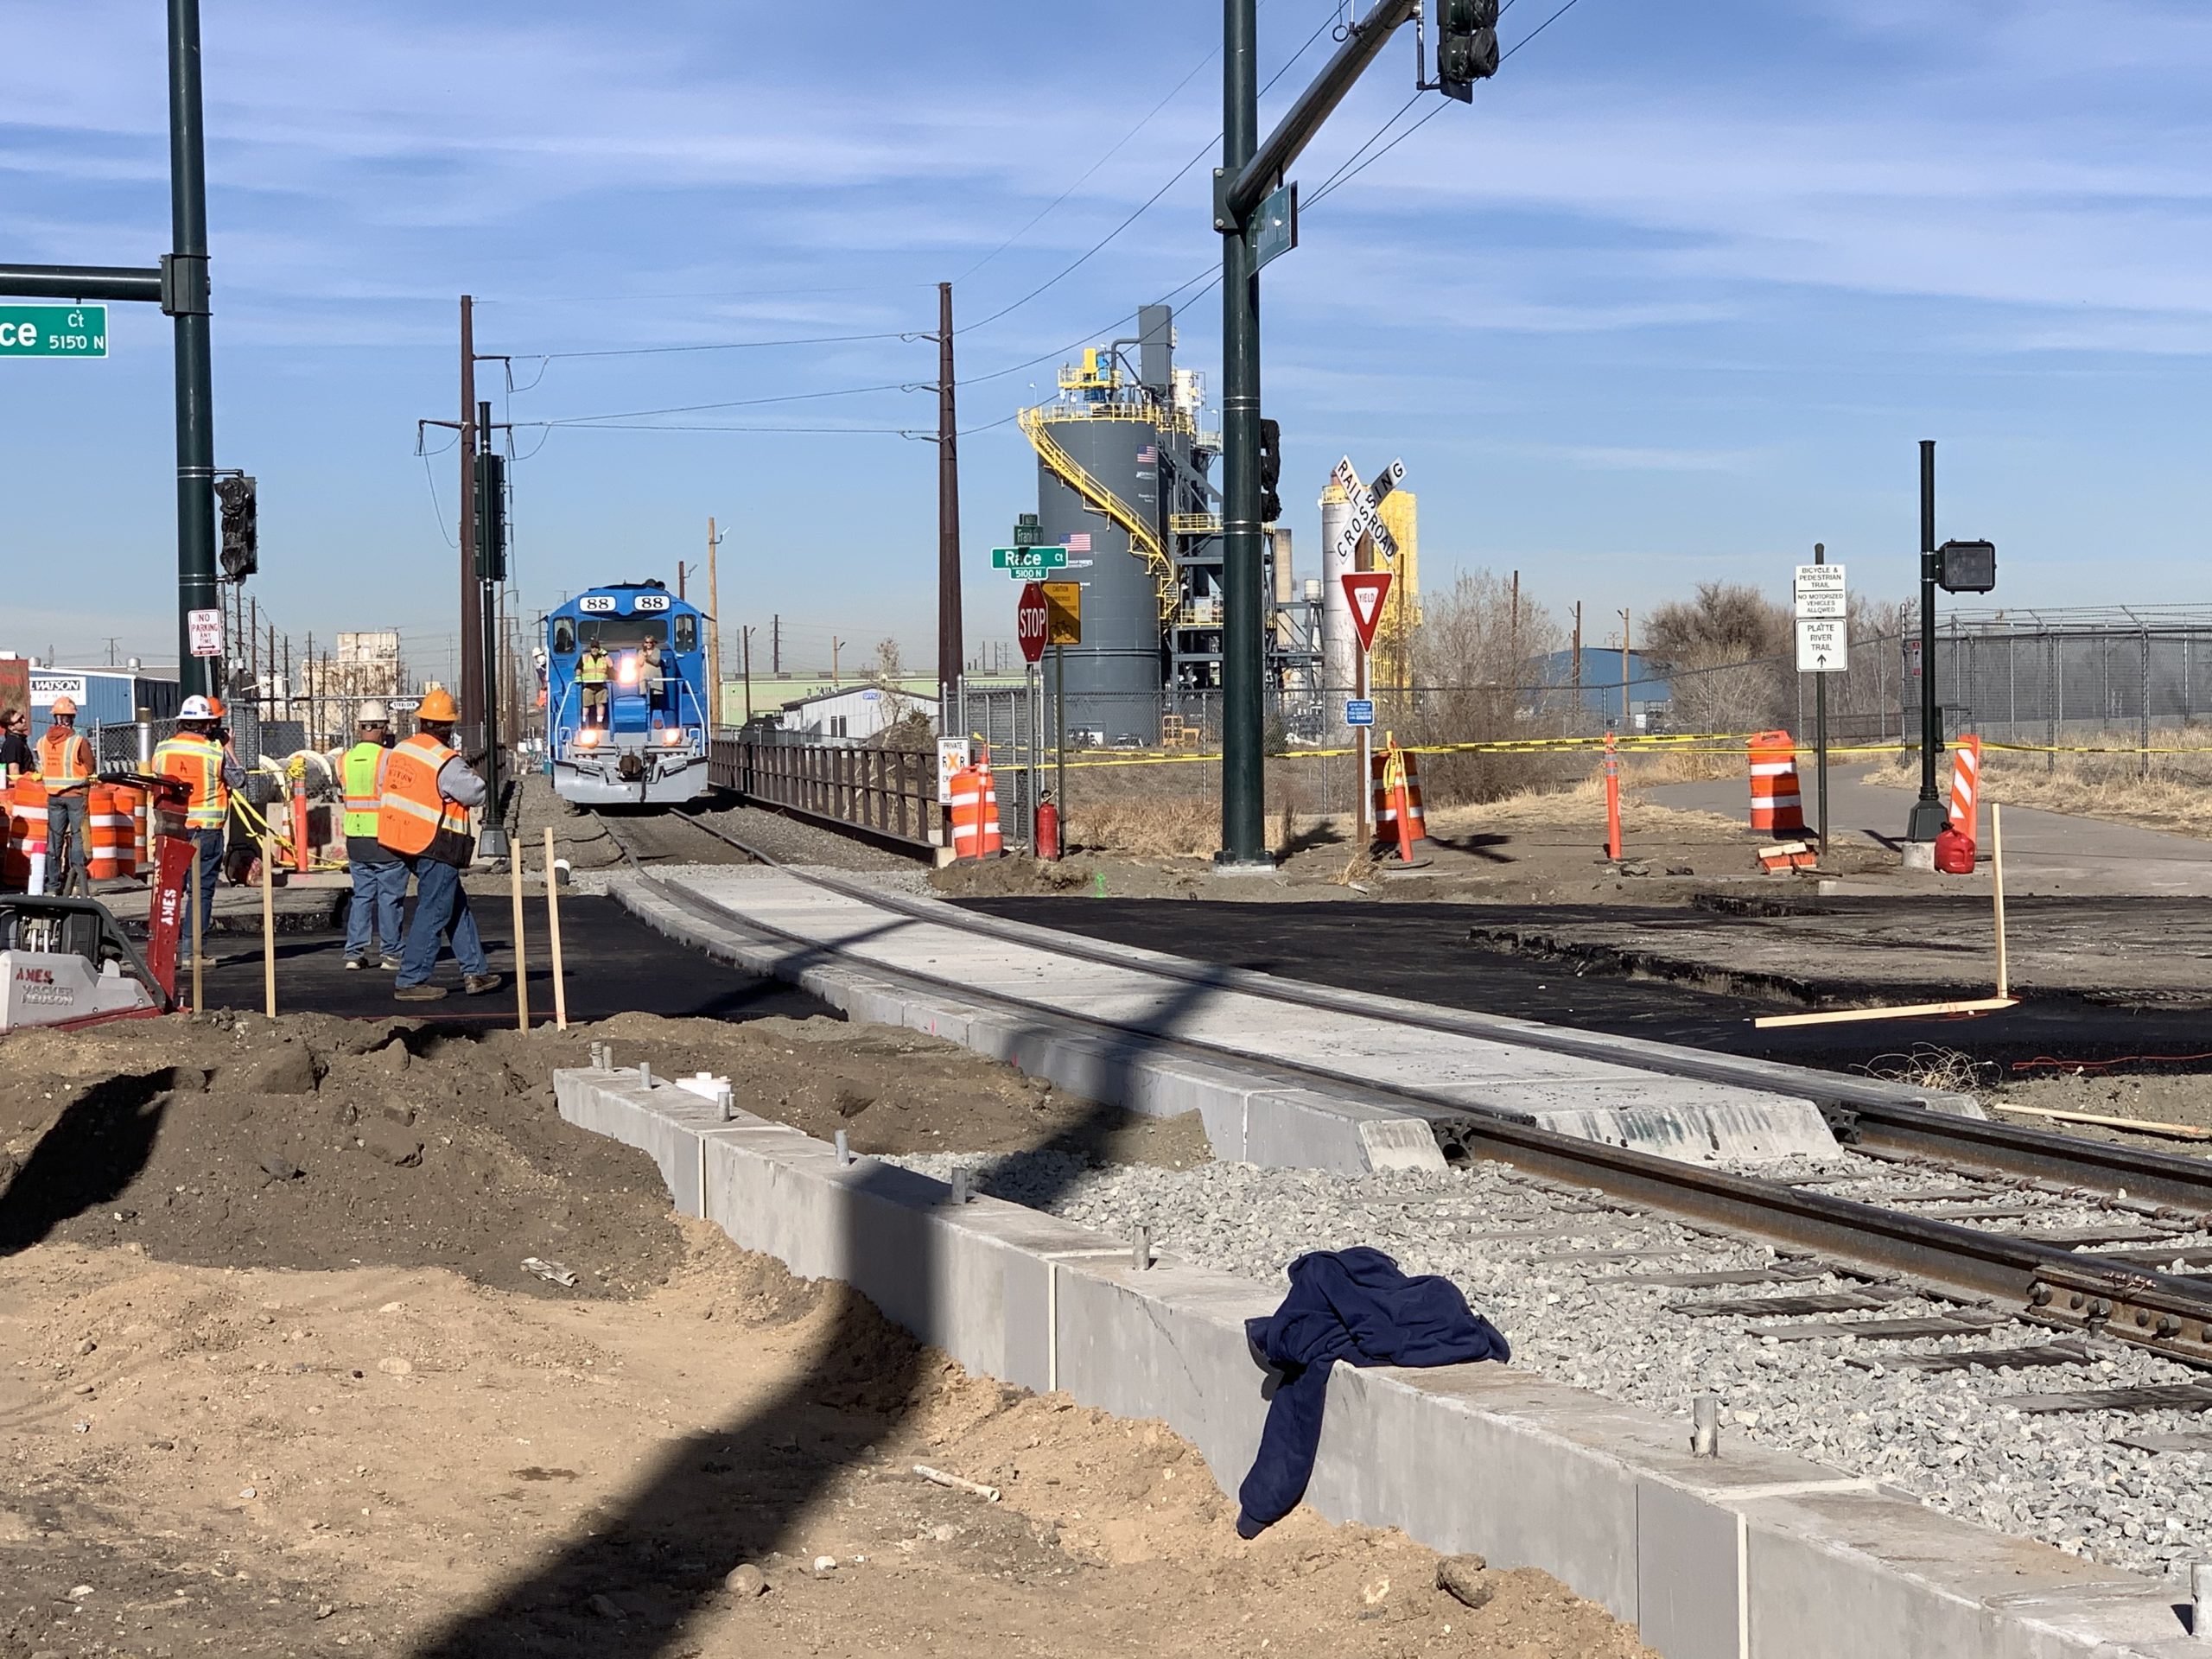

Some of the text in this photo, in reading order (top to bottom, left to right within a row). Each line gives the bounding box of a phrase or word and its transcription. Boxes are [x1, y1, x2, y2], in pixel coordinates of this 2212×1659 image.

[67, 313, 85, 327] Ct
[49, 335, 104, 349] 5150 N
[1337, 462, 1403, 557] CROSSING
[1005, 551, 1064, 566] Race Ct
[1015, 569, 1042, 578] 5100 N
[587, 597, 664, 610] 88 88
[1358, 593, 1375, 603] YIELD
[198, 613, 210, 622] NO
[1020, 607, 1046, 639] STOP
[191, 623, 219, 632] PARKING
